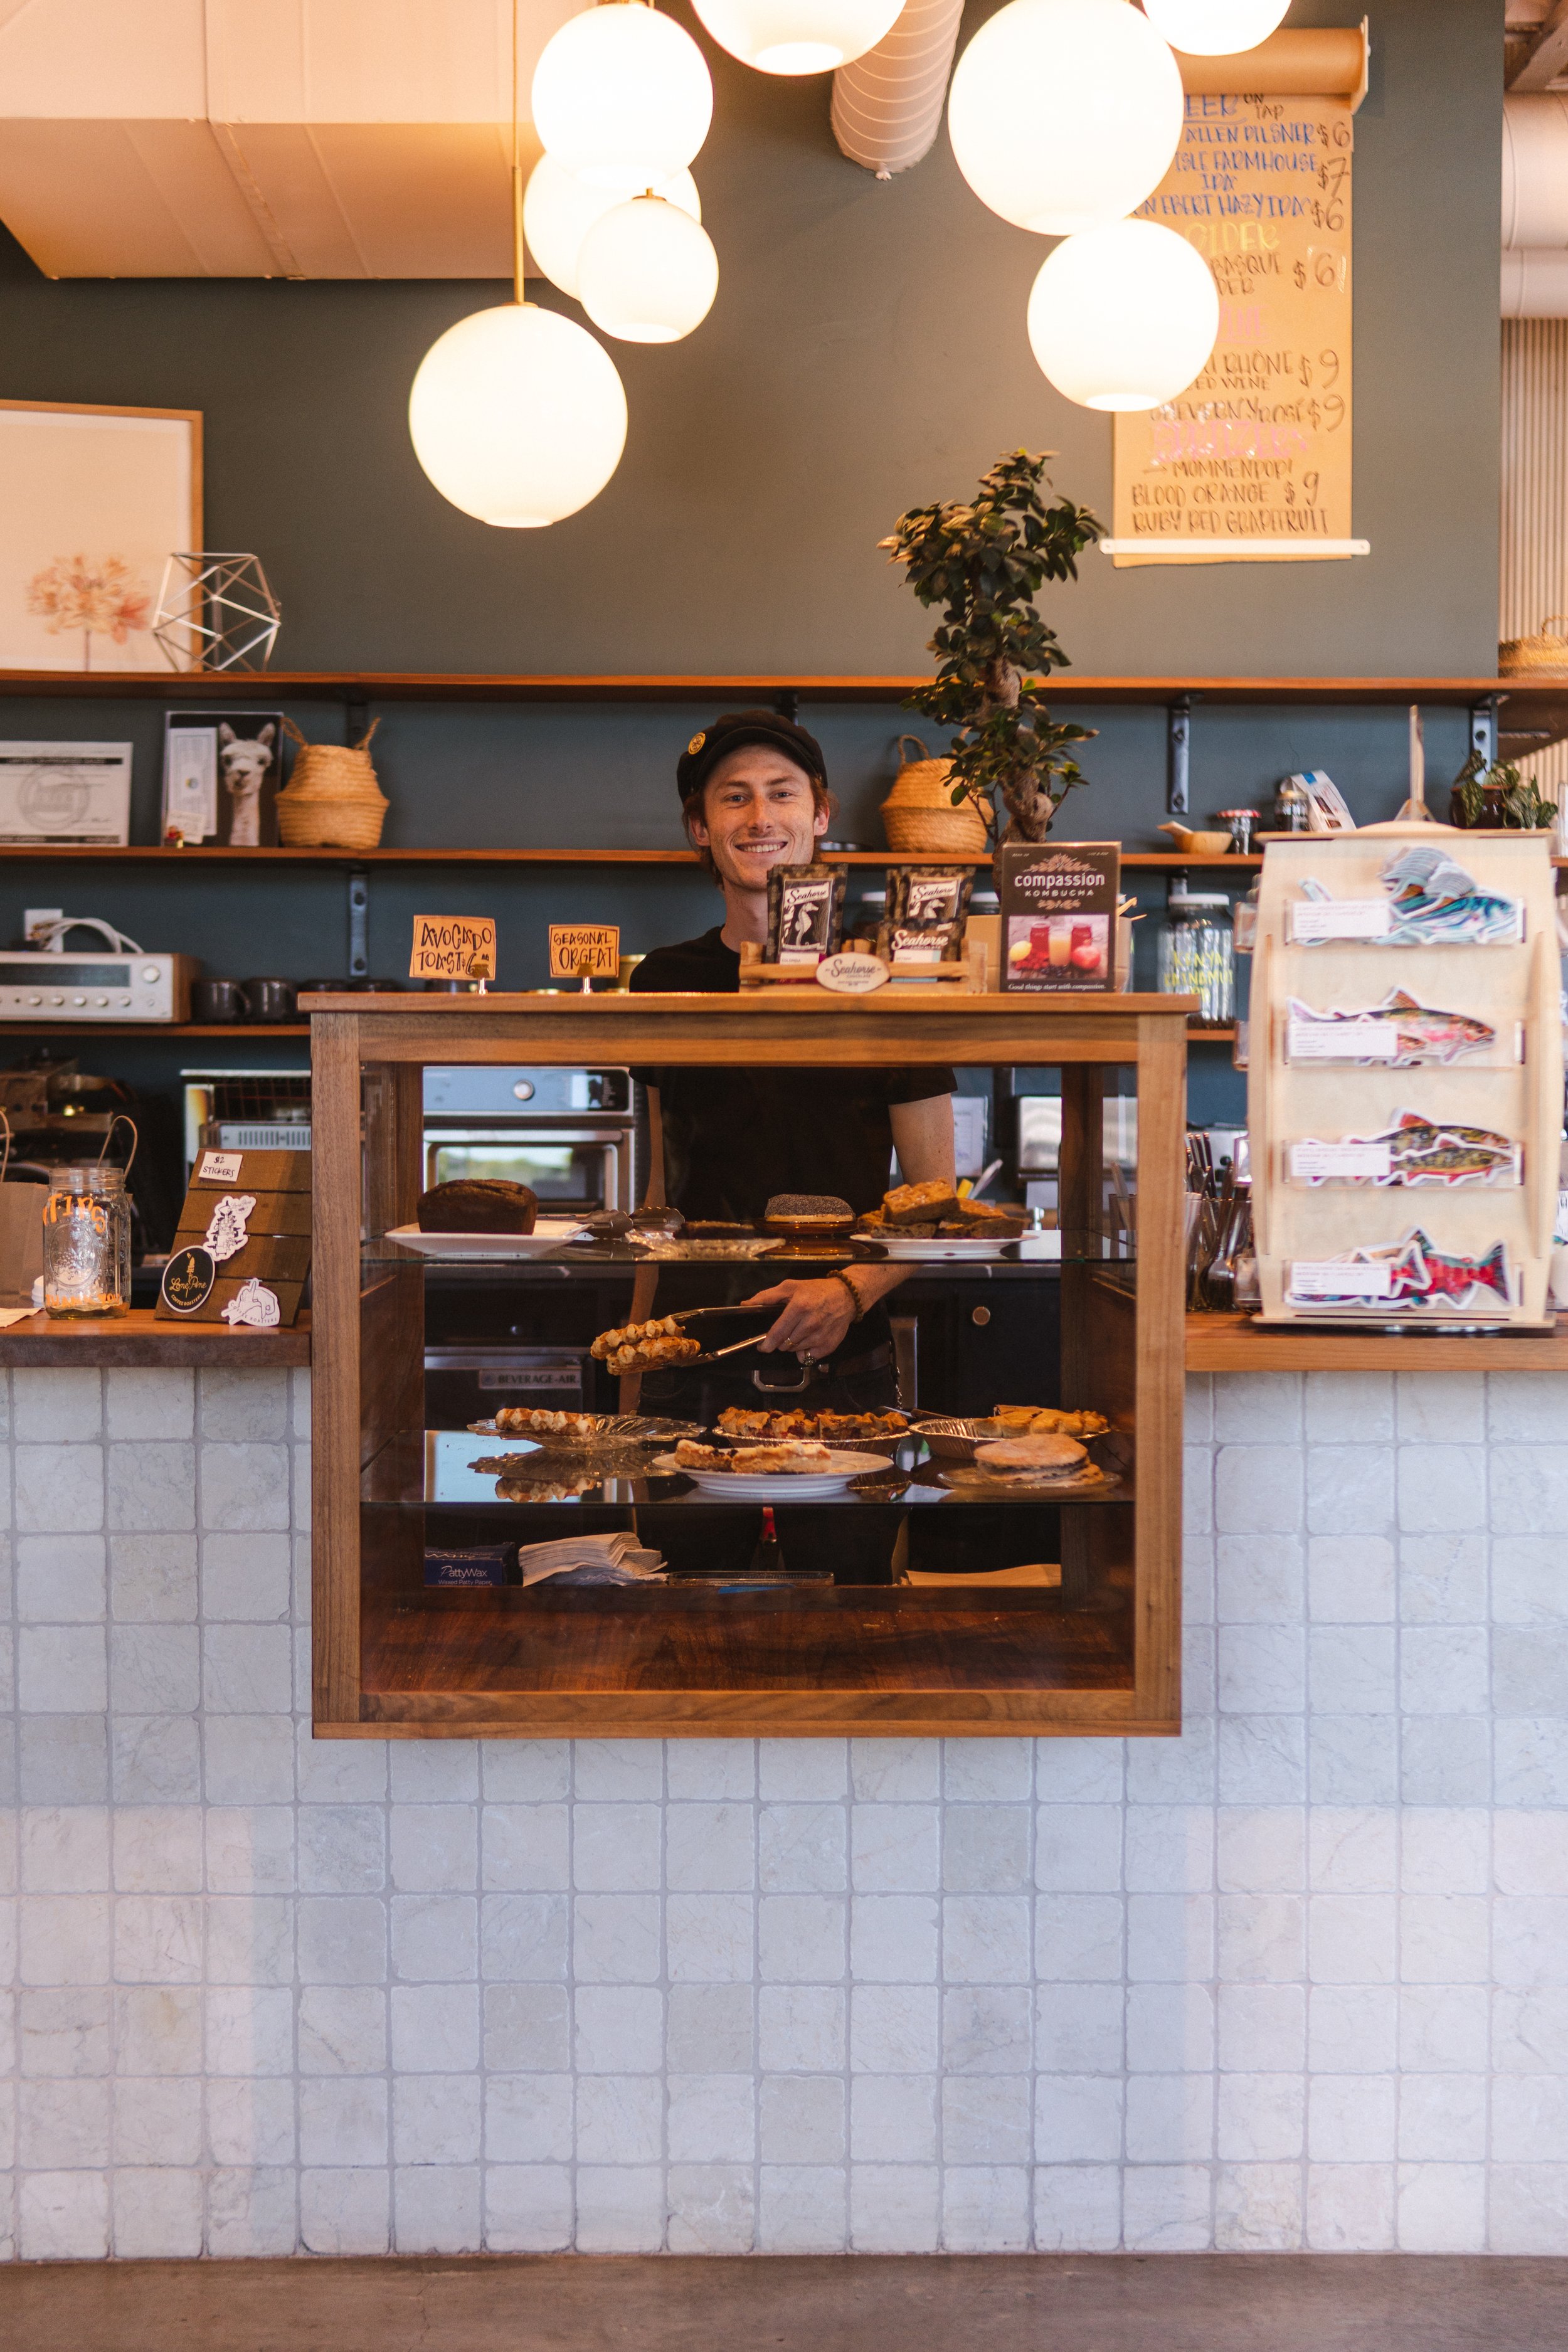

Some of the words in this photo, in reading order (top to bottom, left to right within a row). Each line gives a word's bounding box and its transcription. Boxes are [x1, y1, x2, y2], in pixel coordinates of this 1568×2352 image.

[1185, 94, 1239, 117] EER
[1254, 104, 1285, 121] TAP
[1244, 122, 1316, 147] PILSNER
[1212, 149, 1319, 173] FARMHOUSE
[1200, 172, 1239, 193] IPA
[1217, 193, 1264, 219] HAZY
[1267, 194, 1312, 218] IPA
[1185, 221, 1281, 257] CIDER
[1217, 276, 1255, 296] DER
[1185, 376, 1217, 391] ED
[1220, 374, 1271, 391] WINE
[1131, 482, 1187, 507] BLOOD
[1193, 481, 1271, 505] ORANGE
[1131, 509, 1182, 534] RUBY
[1187, 509, 1221, 534] RED
[1225, 508, 1329, 535] GRAPEFRUIT
[1014, 872, 1105, 890] compassion
[787, 889, 827, 904] Seahorse
[913, 885, 955, 901] Seahorse
[1024, 889, 1094, 898] KOMBUCHA
[420, 922, 492, 951] AVOCADO
[553, 931, 613, 946] SEASONAL
[891, 930, 949, 951] Seahorse
[416, 950, 465, 975] TOAST
[558, 946, 615, 970] ORGEAT
[830, 958, 876, 978] Seahorse
[1024, 983, 1043, 991] things
[202, 1165, 236, 1178] STICKERS
[48, 1192, 107, 1234] TIPS
[169, 1277, 189, 1291] Lone
[189, 1276, 207, 1290] Pine
[171, 1293, 184, 1306] COFFEE
[183, 1293, 203, 1306] ROASTERS
[230, 1301, 248, 1319] COFFEE
[440, 1565, 487, 1579] PattyWax
